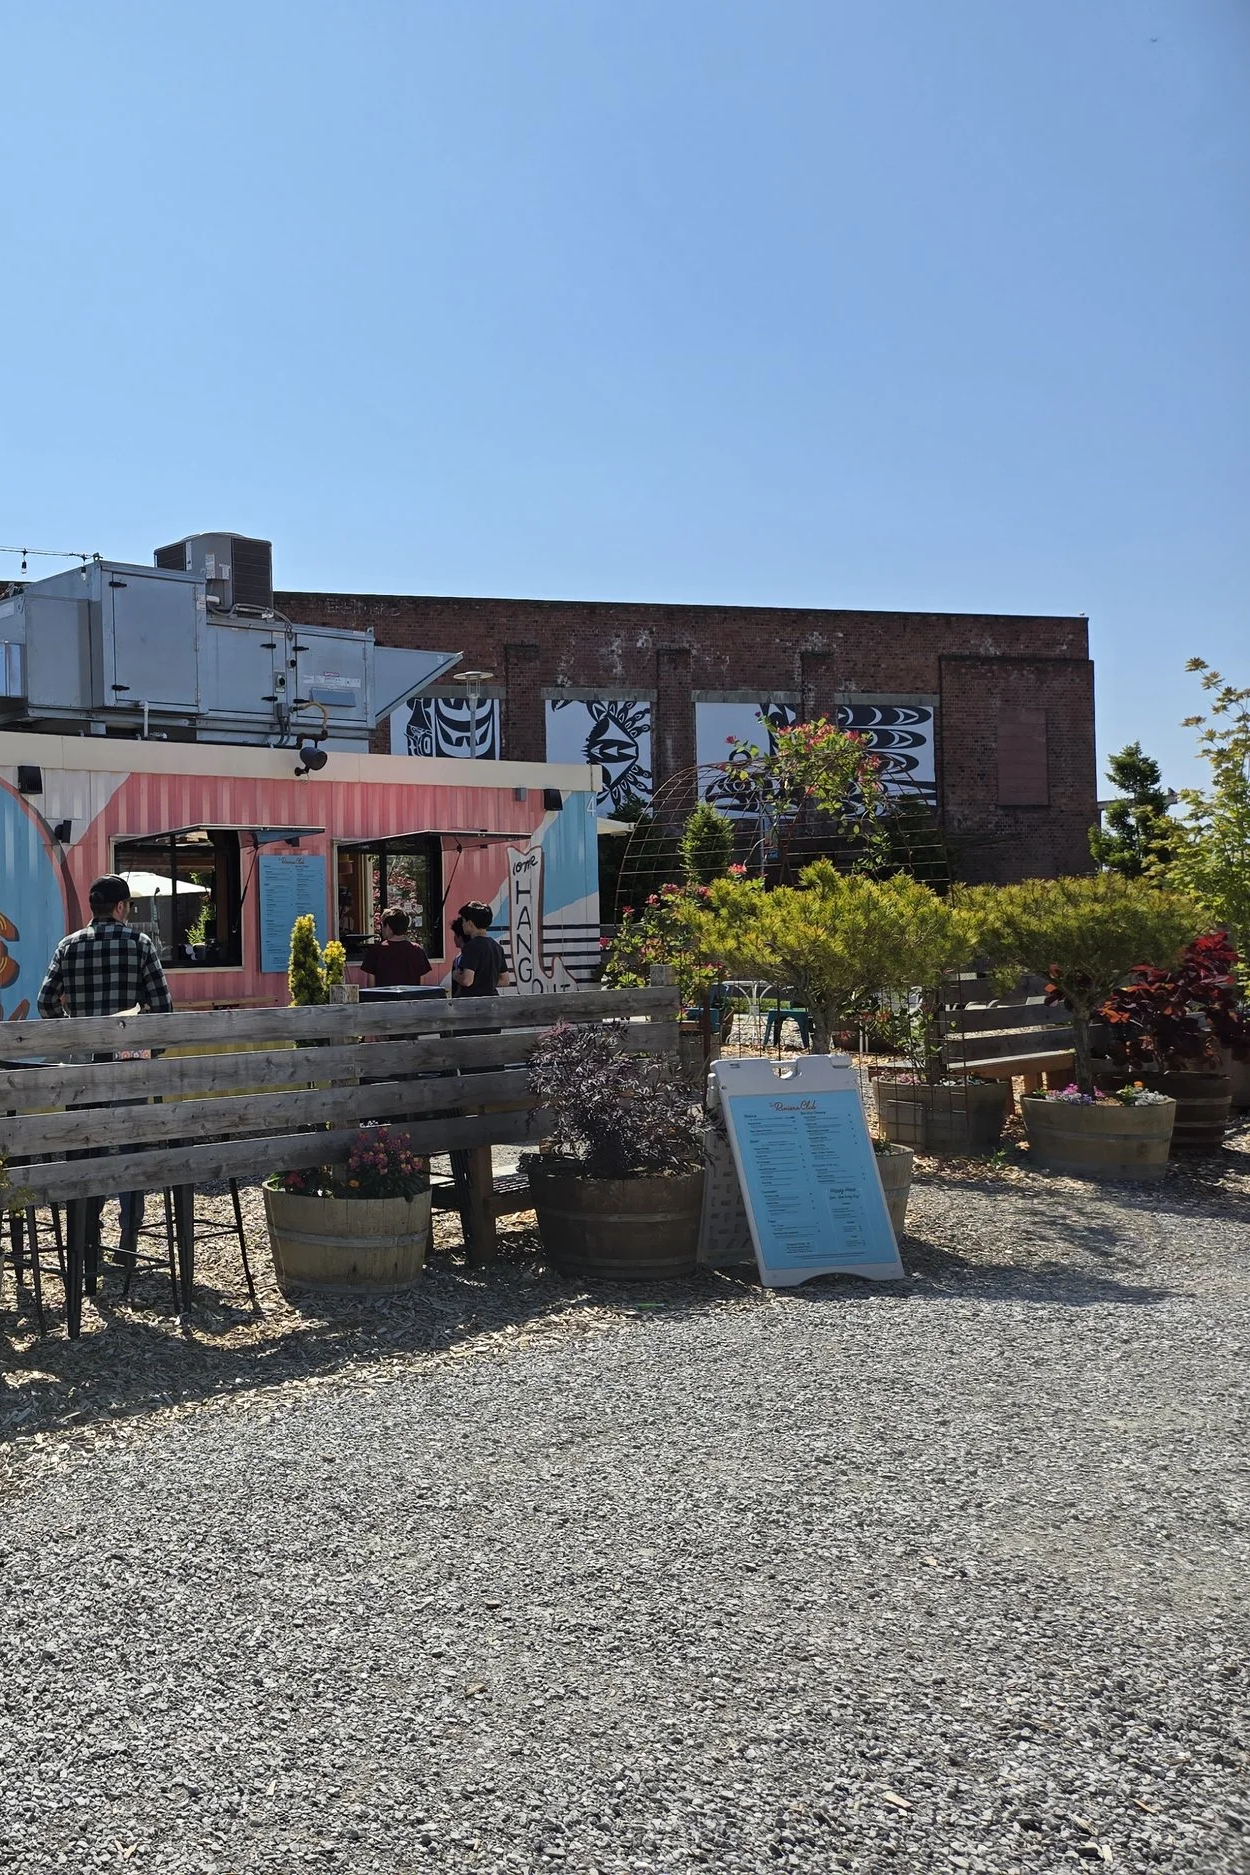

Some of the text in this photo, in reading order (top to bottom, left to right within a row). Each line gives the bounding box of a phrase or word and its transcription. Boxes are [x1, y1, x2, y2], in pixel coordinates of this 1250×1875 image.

[586, 795, 596, 817] 4
[515, 880, 533, 983] HANG
[774, 1101, 800, 1112] Riviera
[800, 1100, 817, 1111] Club
